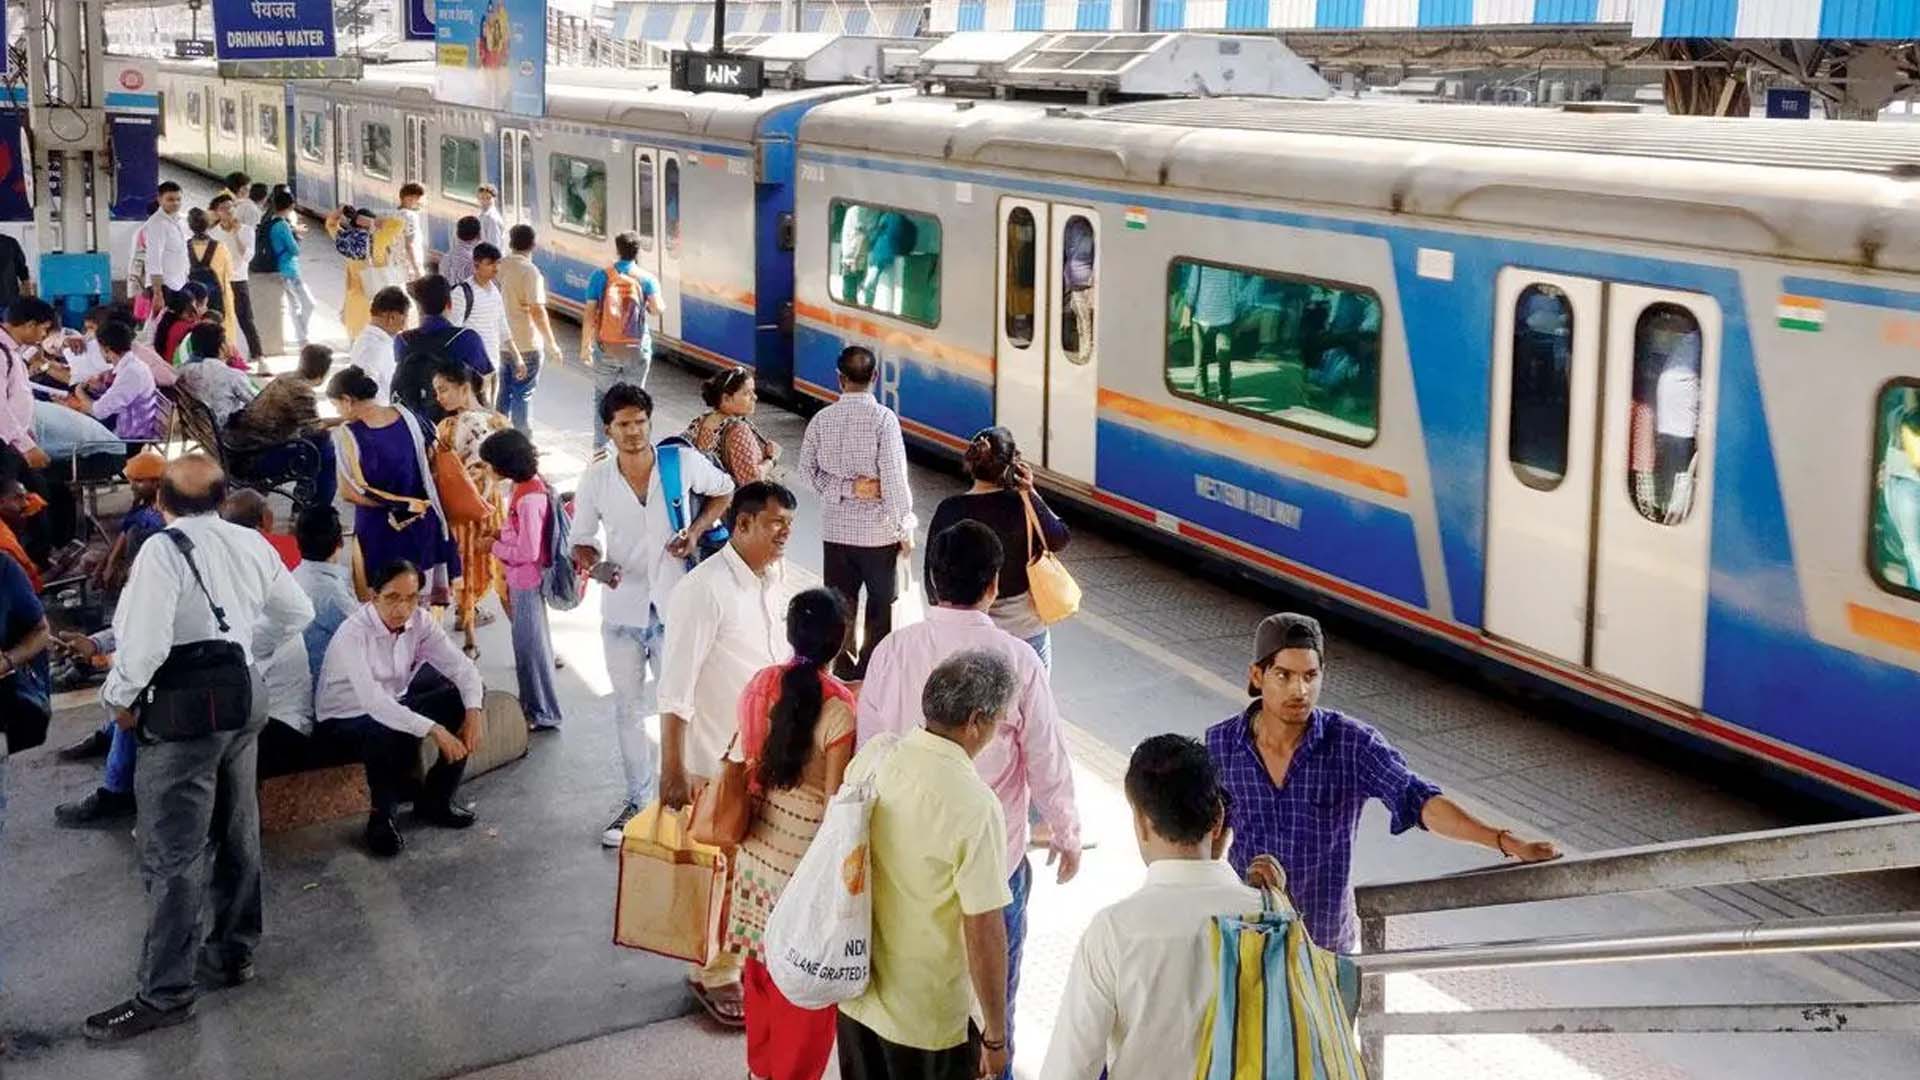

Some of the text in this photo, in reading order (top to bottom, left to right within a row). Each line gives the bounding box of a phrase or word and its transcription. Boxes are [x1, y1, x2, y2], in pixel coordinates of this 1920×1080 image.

[227, 30, 324, 48] DRINKING WATER
[819, 965, 861, 981] GRAFTED
